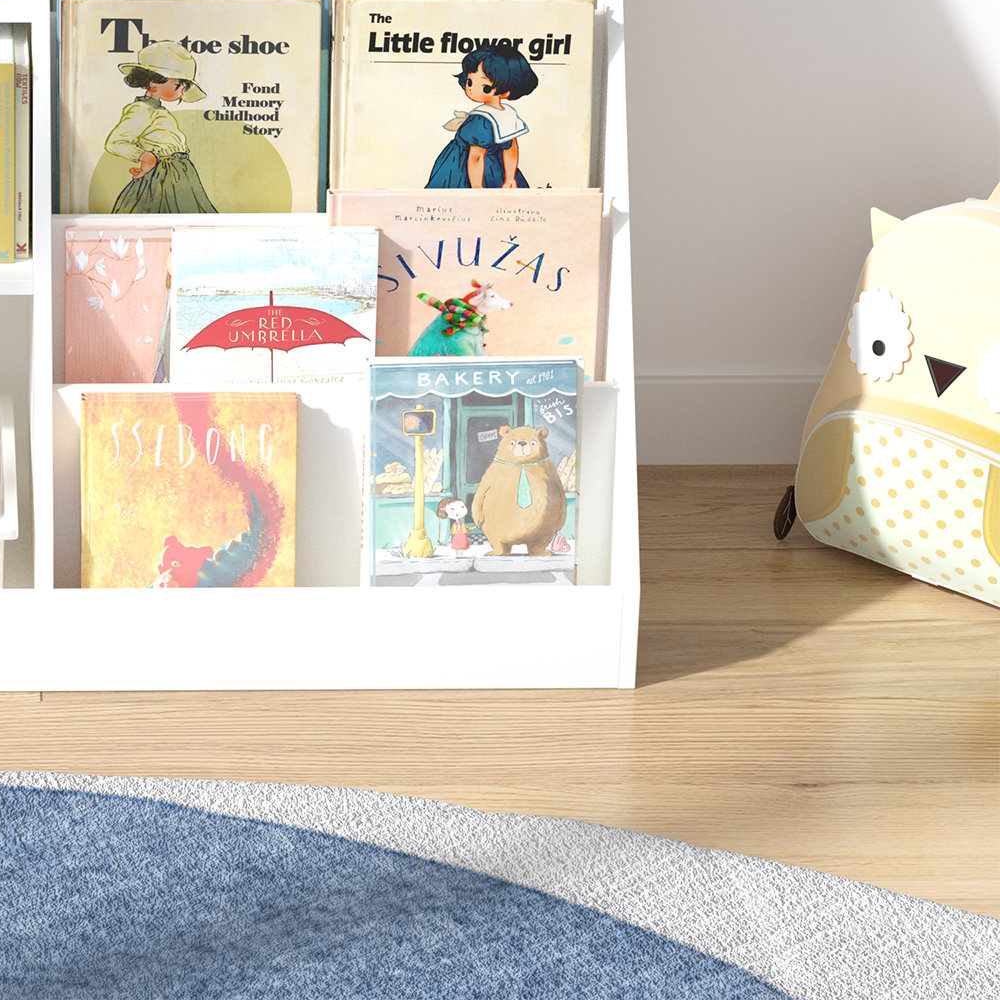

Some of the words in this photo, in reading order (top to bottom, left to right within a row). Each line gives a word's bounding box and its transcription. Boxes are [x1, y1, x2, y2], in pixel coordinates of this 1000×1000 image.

[369, 13, 393, 24] The
[179, 35, 222, 55] toe
[227, 34, 290, 55] shoe
[368, 31, 434, 54] Little
[439, 32, 523, 54] flower
[528, 33, 572, 62] girl
[241, 82, 281, 94] Fond
[222, 96, 284, 111] Memory
[203, 109, 280, 122] Childhood
[242, 124, 284, 139] Story
[259, 317, 292, 330] RED
[228, 329, 324, 343] UMBRELLA
[417, 370, 520, 388] BAKERY
